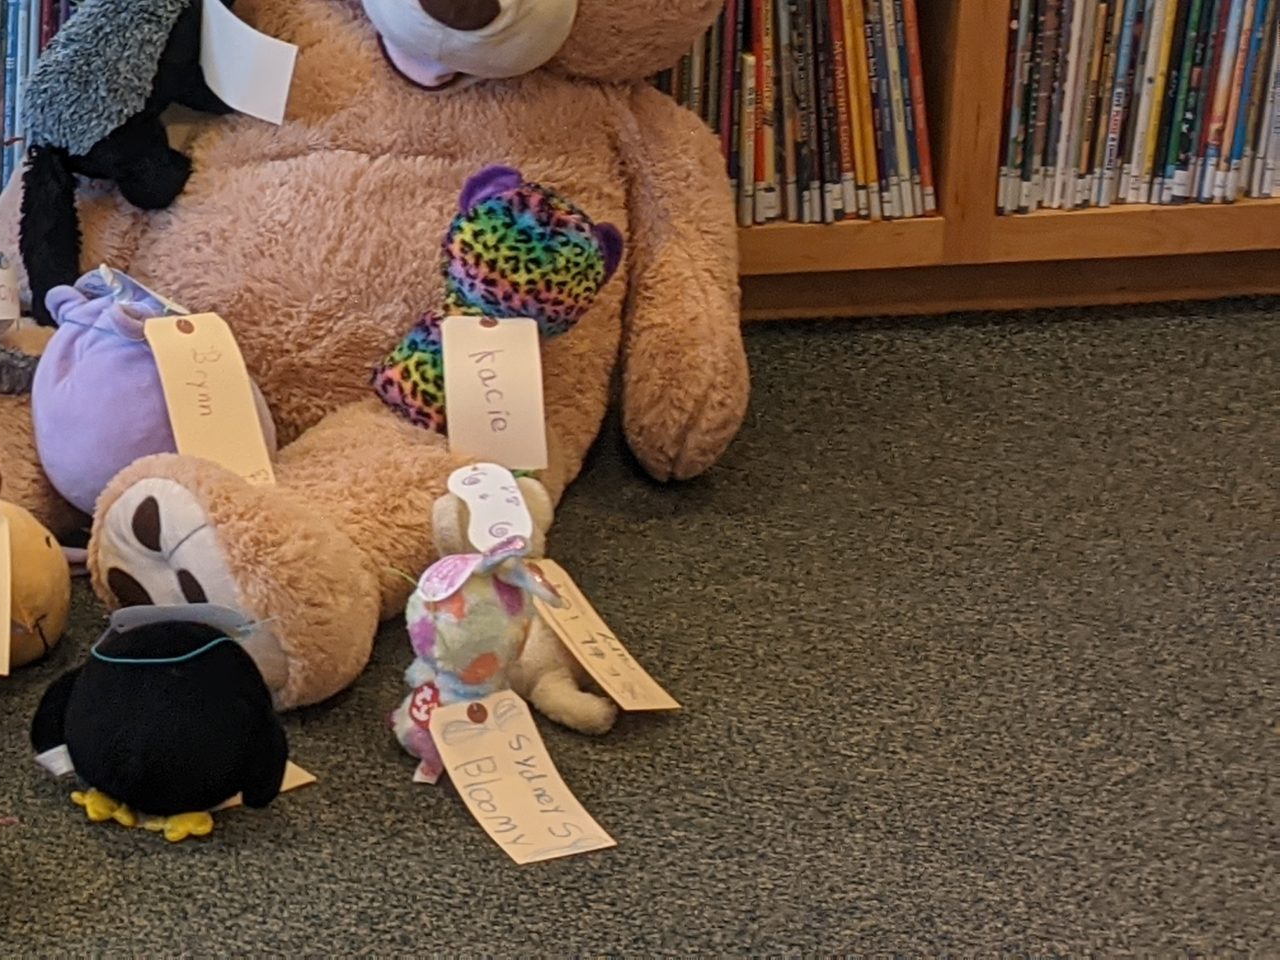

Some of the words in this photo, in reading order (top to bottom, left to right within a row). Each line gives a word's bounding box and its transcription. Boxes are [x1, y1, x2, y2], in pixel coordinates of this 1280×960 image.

[834, 66, 847, 115] MOTHER
[839, 125, 851, 171] GOOSE
[194, 344, 223, 419] Brynn
[468, 348, 508, 435] Kacie
[455, 753, 528, 849] Bloomy
[508, 733, 566, 816] Sydney
